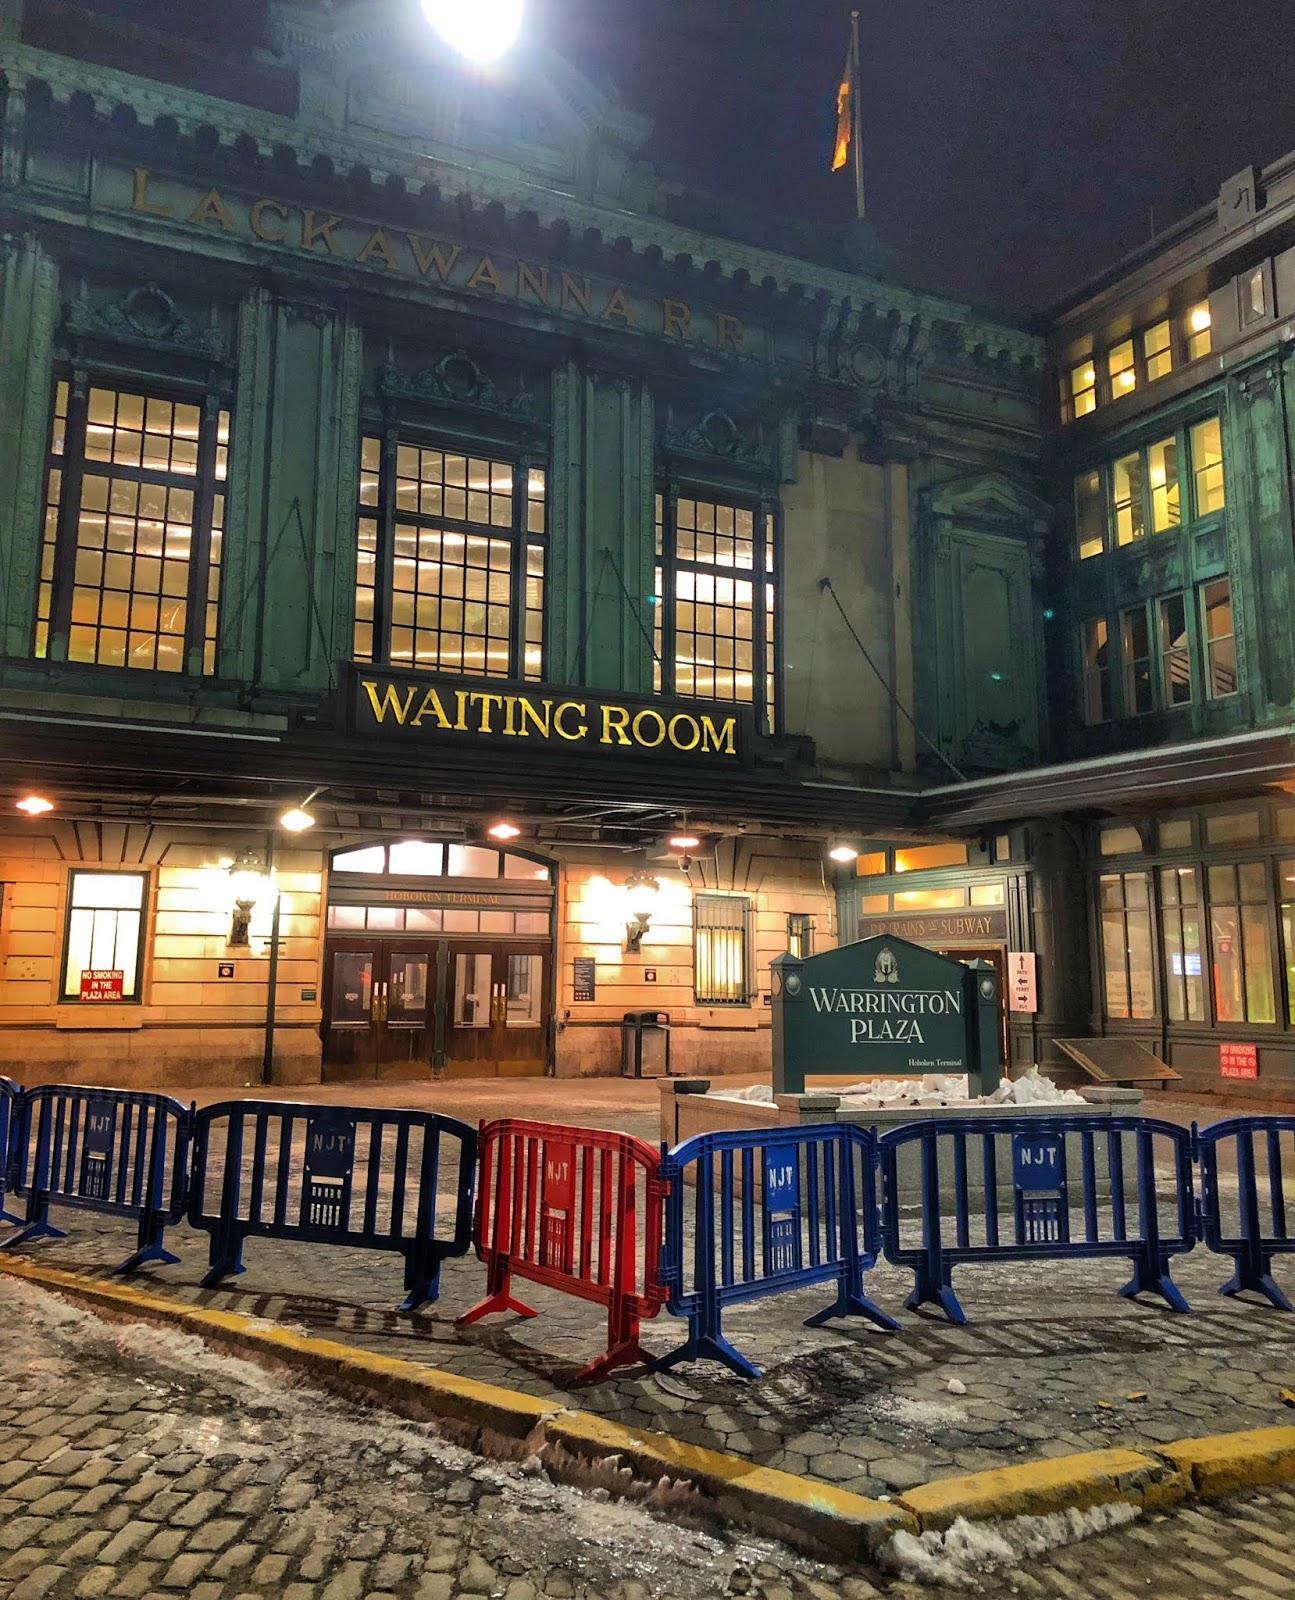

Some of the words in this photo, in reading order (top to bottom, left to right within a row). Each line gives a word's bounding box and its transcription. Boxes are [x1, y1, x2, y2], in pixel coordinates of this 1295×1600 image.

[132, 167, 639, 327] LACKAWANNA
[361, 681, 588, 741] WAITING
[600, 705, 737, 755] ROOM
[384, 890, 441, 902] HOBOKEN
[447, 892, 501, 904] TERMINAL
[941, 917, 992, 935] SUBWAY
[82, 971, 92, 980] NO
[93, 971, 122, 980] SMOKING
[91, 981, 99, 990] IN
[100, 981, 113, 990] THE
[81, 991, 103, 1000] PLAZA
[103, 991, 121, 1000] AREA
[808, 987, 962, 1015] WARRINGTON
[851, 1019, 925, 1044] PLAZA
[908, 1058, 935, 1067] Hoboken
[936, 1058, 962, 1067] Terminal
[90, 1115, 111, 1131] NJT
[313, 1134, 346, 1152] NJT
[1021, 1147, 1057, 1167] NJT
[547, 1160, 569, 1182] NJT
[769, 1166, 793, 1189] NJT
